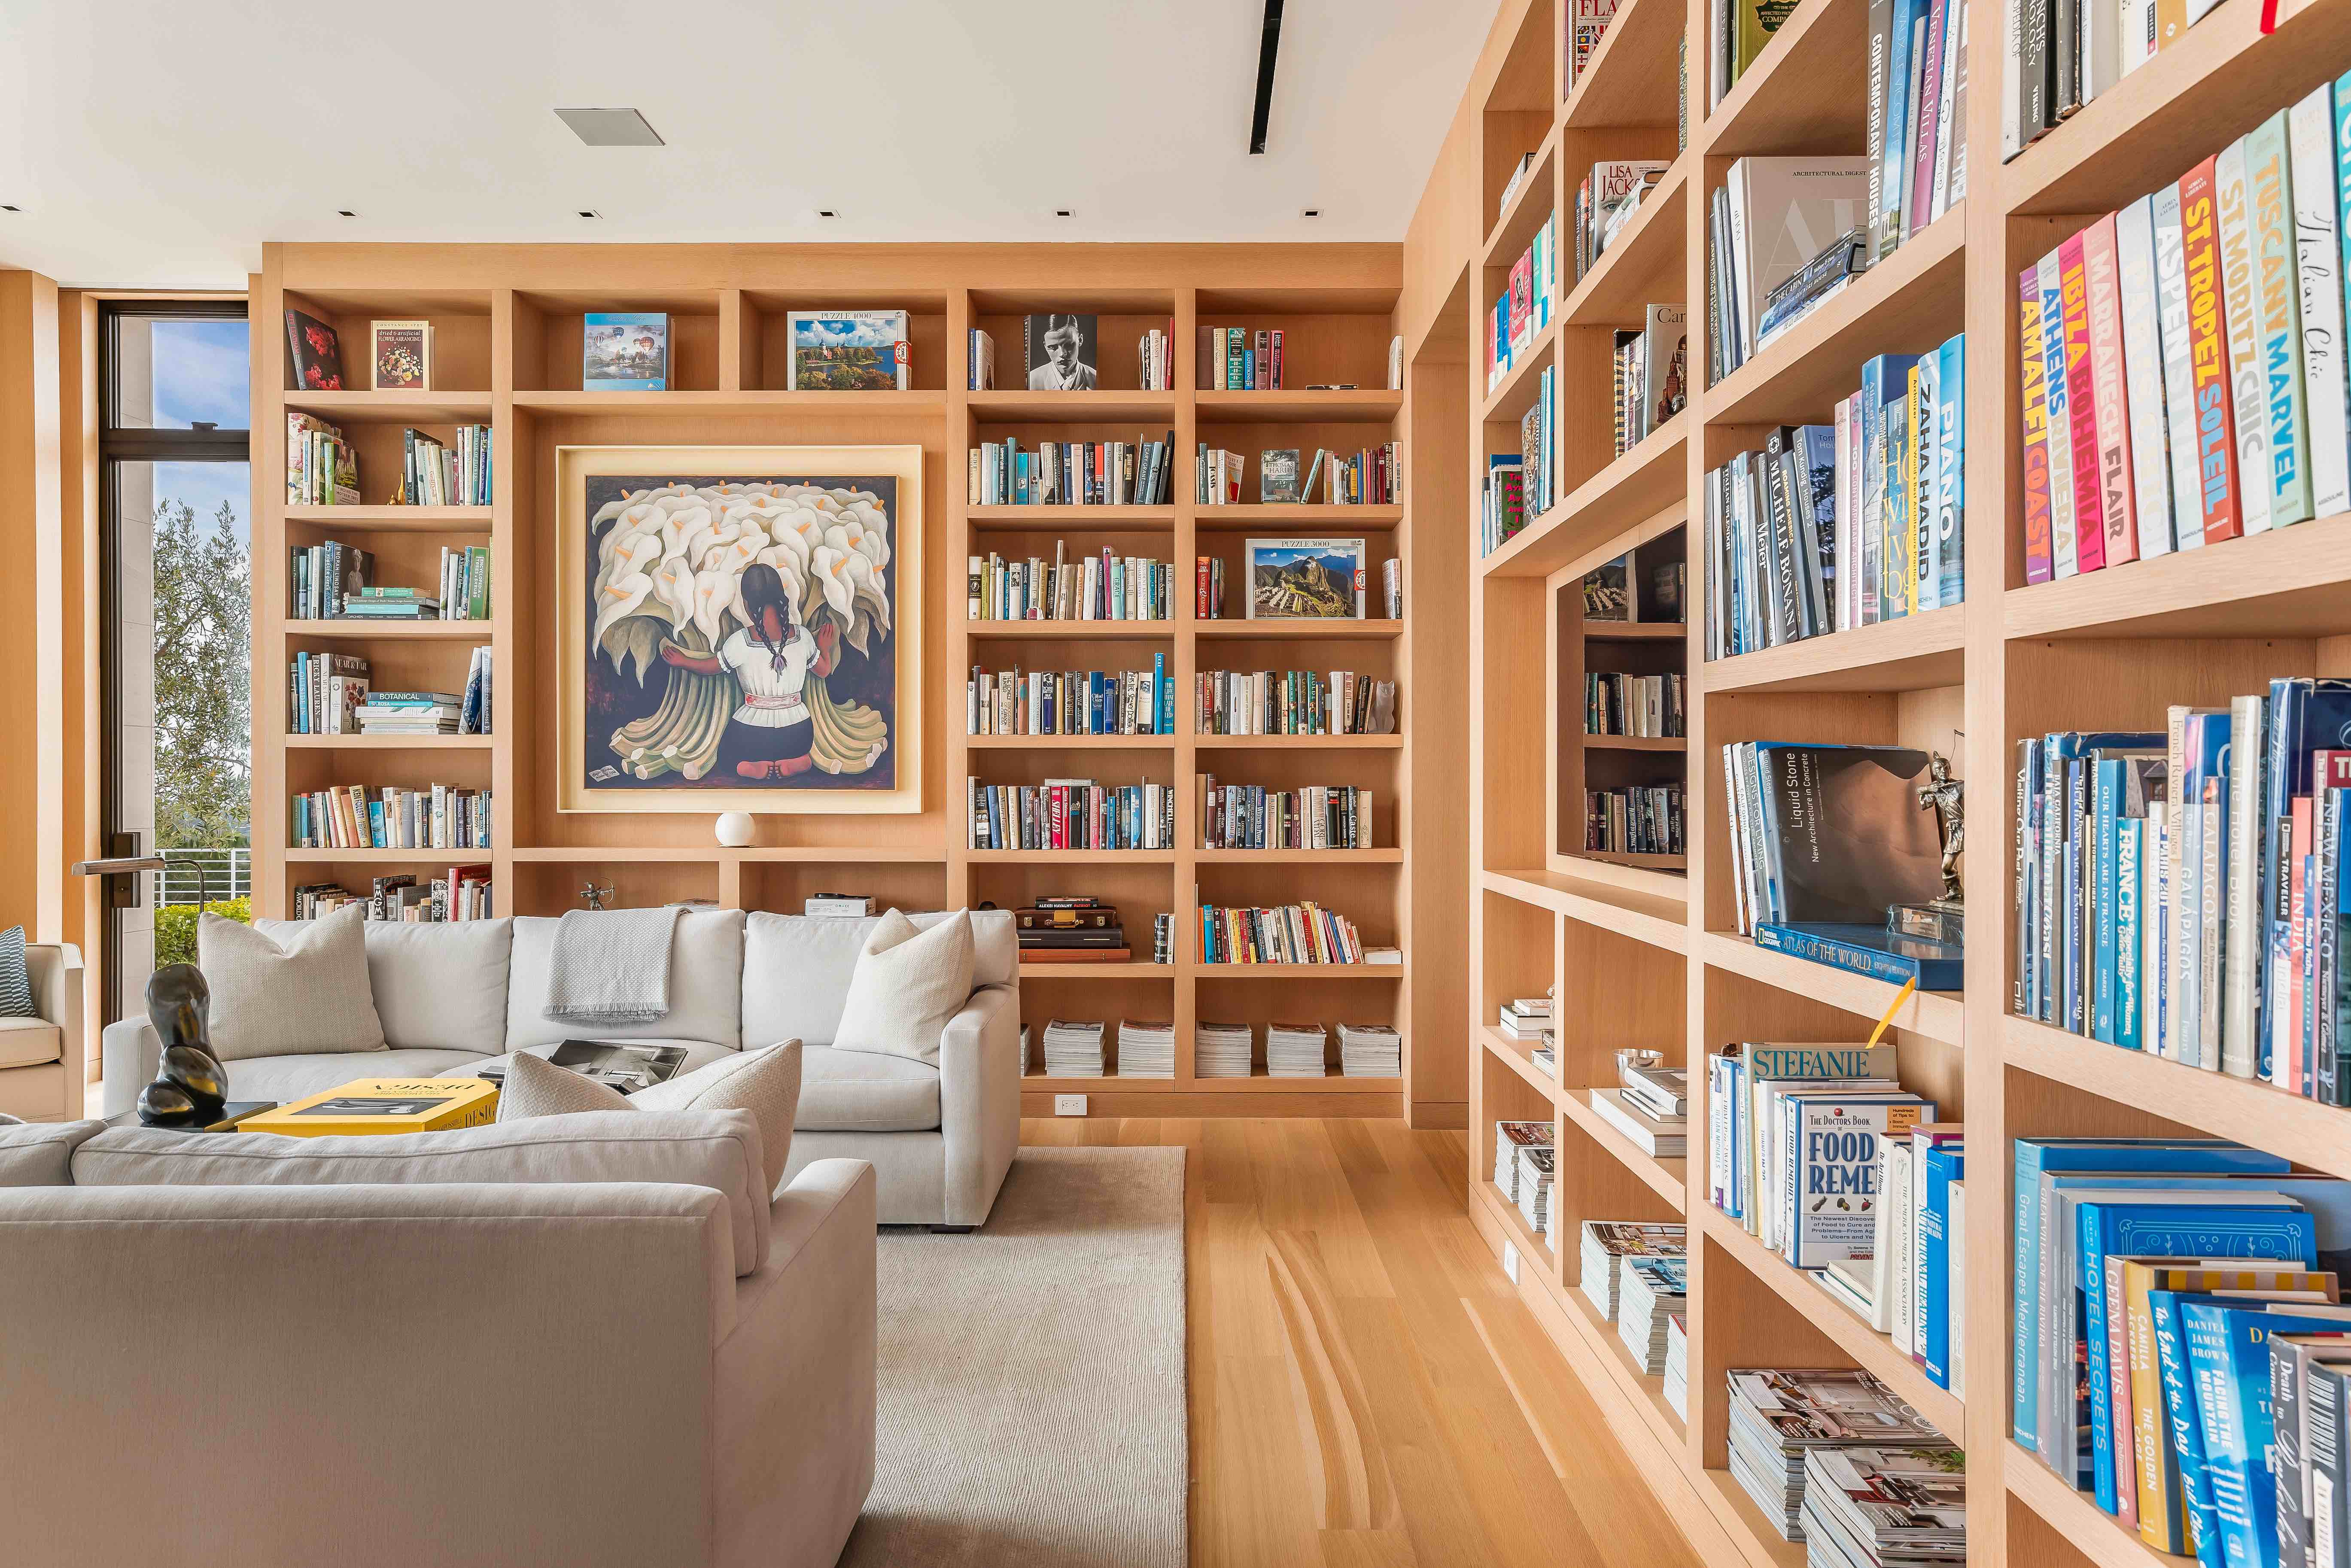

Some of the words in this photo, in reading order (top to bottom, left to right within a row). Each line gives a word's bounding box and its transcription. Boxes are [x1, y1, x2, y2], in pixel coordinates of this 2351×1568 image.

[1925, 5, 1941, 97] VENETIAN
[1870, 33, 1882, 161] CONTEMPORARY
[1919, 100, 1934, 162] VILLAS
[1609, 165, 1632, 178] LISA
[1869, 166, 1880, 229] HOUSES
[2186, 197, 2212, 251] ST.
[2221, 179, 2245, 236] ST.
[2254, 154, 2288, 334] TUSCANY
[2296, 211, 2332, 314] Italian
[2062, 262, 2089, 371] IBIZA
[2156, 225, 2190, 365] ASPEN
[2189, 243, 2220, 387] TROPEZ
[2225, 229, 2256, 374] MORITZ
[2022, 301, 2047, 446] AMALFI
[2043, 289, 2065, 416] ATHENS
[2091, 249, 2120, 449] MARRAKECH
[2305, 328, 2331, 378] Chic
[1818, 434, 1835, 442] Tom
[1919, 383, 1930, 474] ZAHA
[2167, 356, 2198, 497] STYLE
[2238, 371, 2263, 460] CHIC
[2266, 333, 2295, 496] MARVEL
[1795, 437, 1804, 452] Tom
[1798, 453, 1807, 487] Kundig
[1940, 401, 1954, 541] PIANO
[2070, 365, 2099, 545] BOHEMIA
[2198, 383, 2227, 515] SOLEIL
[1782, 469, 1791, 507] ROAMING
[1803, 489, 1811, 520] Houses
[2026, 447, 2048, 557] COAST
[2050, 412, 2072, 554] RIVIERA
[2105, 446, 2125, 541] FLAIR
[1757, 520, 1768, 569] Meier
[1770, 459, 1789, 554] MICHELE
[1780, 558, 1795, 626] BÖNAN
[1919, 479, 1930, 581] HADID
[2173, 720, 2183, 759] French
[1786, 752, 1797, 788] Stone
[2172, 765, 2181, 806] Riviera
[1052, 800, 1061, 834] SHELLEY
[1747, 750, 1757, 800] DESIGNS
[1755, 830, 1764, 870] LIVING
[1787, 791, 1803, 828] Liquid
[1807, 797, 1818, 844] Architecture
[2171, 811, 2181, 855] Villages
[2102, 887, 2109, 899] IN
[2118, 828, 2135, 921] FRANCE
[2202, 812, 2215, 924] GALAPAGOS
[2280, 859, 2290, 916] TRAVELER
[2293, 892, 2304, 952] INDIA
[1783, 938, 1806, 954] ATLAS
[1807, 941, 1819, 957] OF
[1819, 944, 1836, 962] THE
[1838, 950, 1871, 970] WORLD
[1753, 1050, 1870, 1078] STEFANIE
[1809, 1132, 1874, 1162] FOOD
[1810, 1115, 1822, 1125] THE
[1823, 1115, 1851, 1125] DOCTORS
[1852, 1116, 1871, 1125] BOOK
[1808, 1164, 1877, 1194] REME
[2019, 1194, 2030, 1230] Great
[1919, 1204, 1927, 1282] NUTRITIONAL
[2018, 1237, 2029, 1295] Escapes
[2040, 1264, 2046, 1276] OF
[1918, 1285, 1927, 1339] HEALING
[2087, 1252, 2101, 1330] HOTEL
[2107, 1270, 2121, 1333] GEENA
[2155, 1307, 2169, 1328] The
[2017, 1299, 2029, 1403] Mediterranean
[2138, 1315, 2150, 1370] CAMILLA
[2157, 1329, 2179, 1371] End
[2187, 1319, 2229, 1334] DANIEL
[2192, 1333, 2225, 1346] JAMES
[2192, 1349, 2229, 1361] BROWN
[2110, 1337, 2124, 1396] DAVIS
[2167, 1369, 2183, 1390] of
[2281, 1360, 2294, 1402] Death
[2090, 1339, 2106, 1452] SECRETS
[2143, 1408, 2152, 1432] THE
[2170, 1390, 2183, 1412] the
[2199, 1370, 2220, 1443] MOUNTAIN
[2134, 1426, 2143, 1462] CAGE
[2144, 1434, 2157, 1491] GOLDEN
[2173, 1416, 2189, 1456] Day
